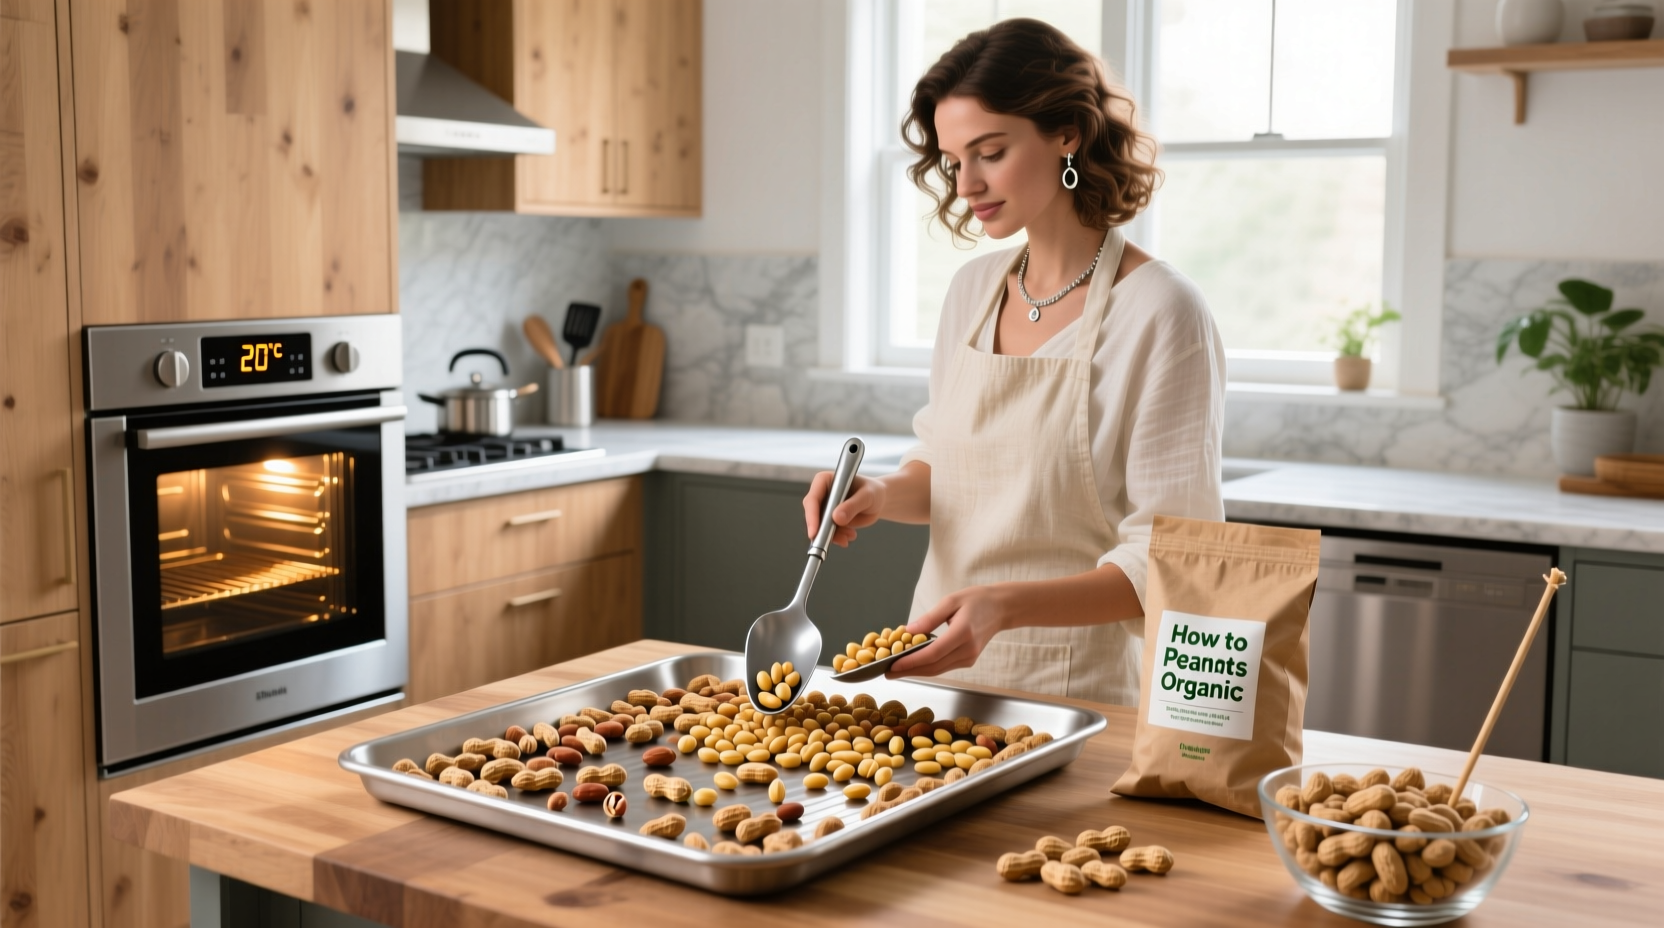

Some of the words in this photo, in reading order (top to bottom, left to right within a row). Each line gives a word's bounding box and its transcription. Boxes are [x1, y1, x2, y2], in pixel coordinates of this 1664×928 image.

[1171, 623, 1220, 648] How
[1225, 632, 1248, 652] to
[1161, 671, 1243, 702] Organic
